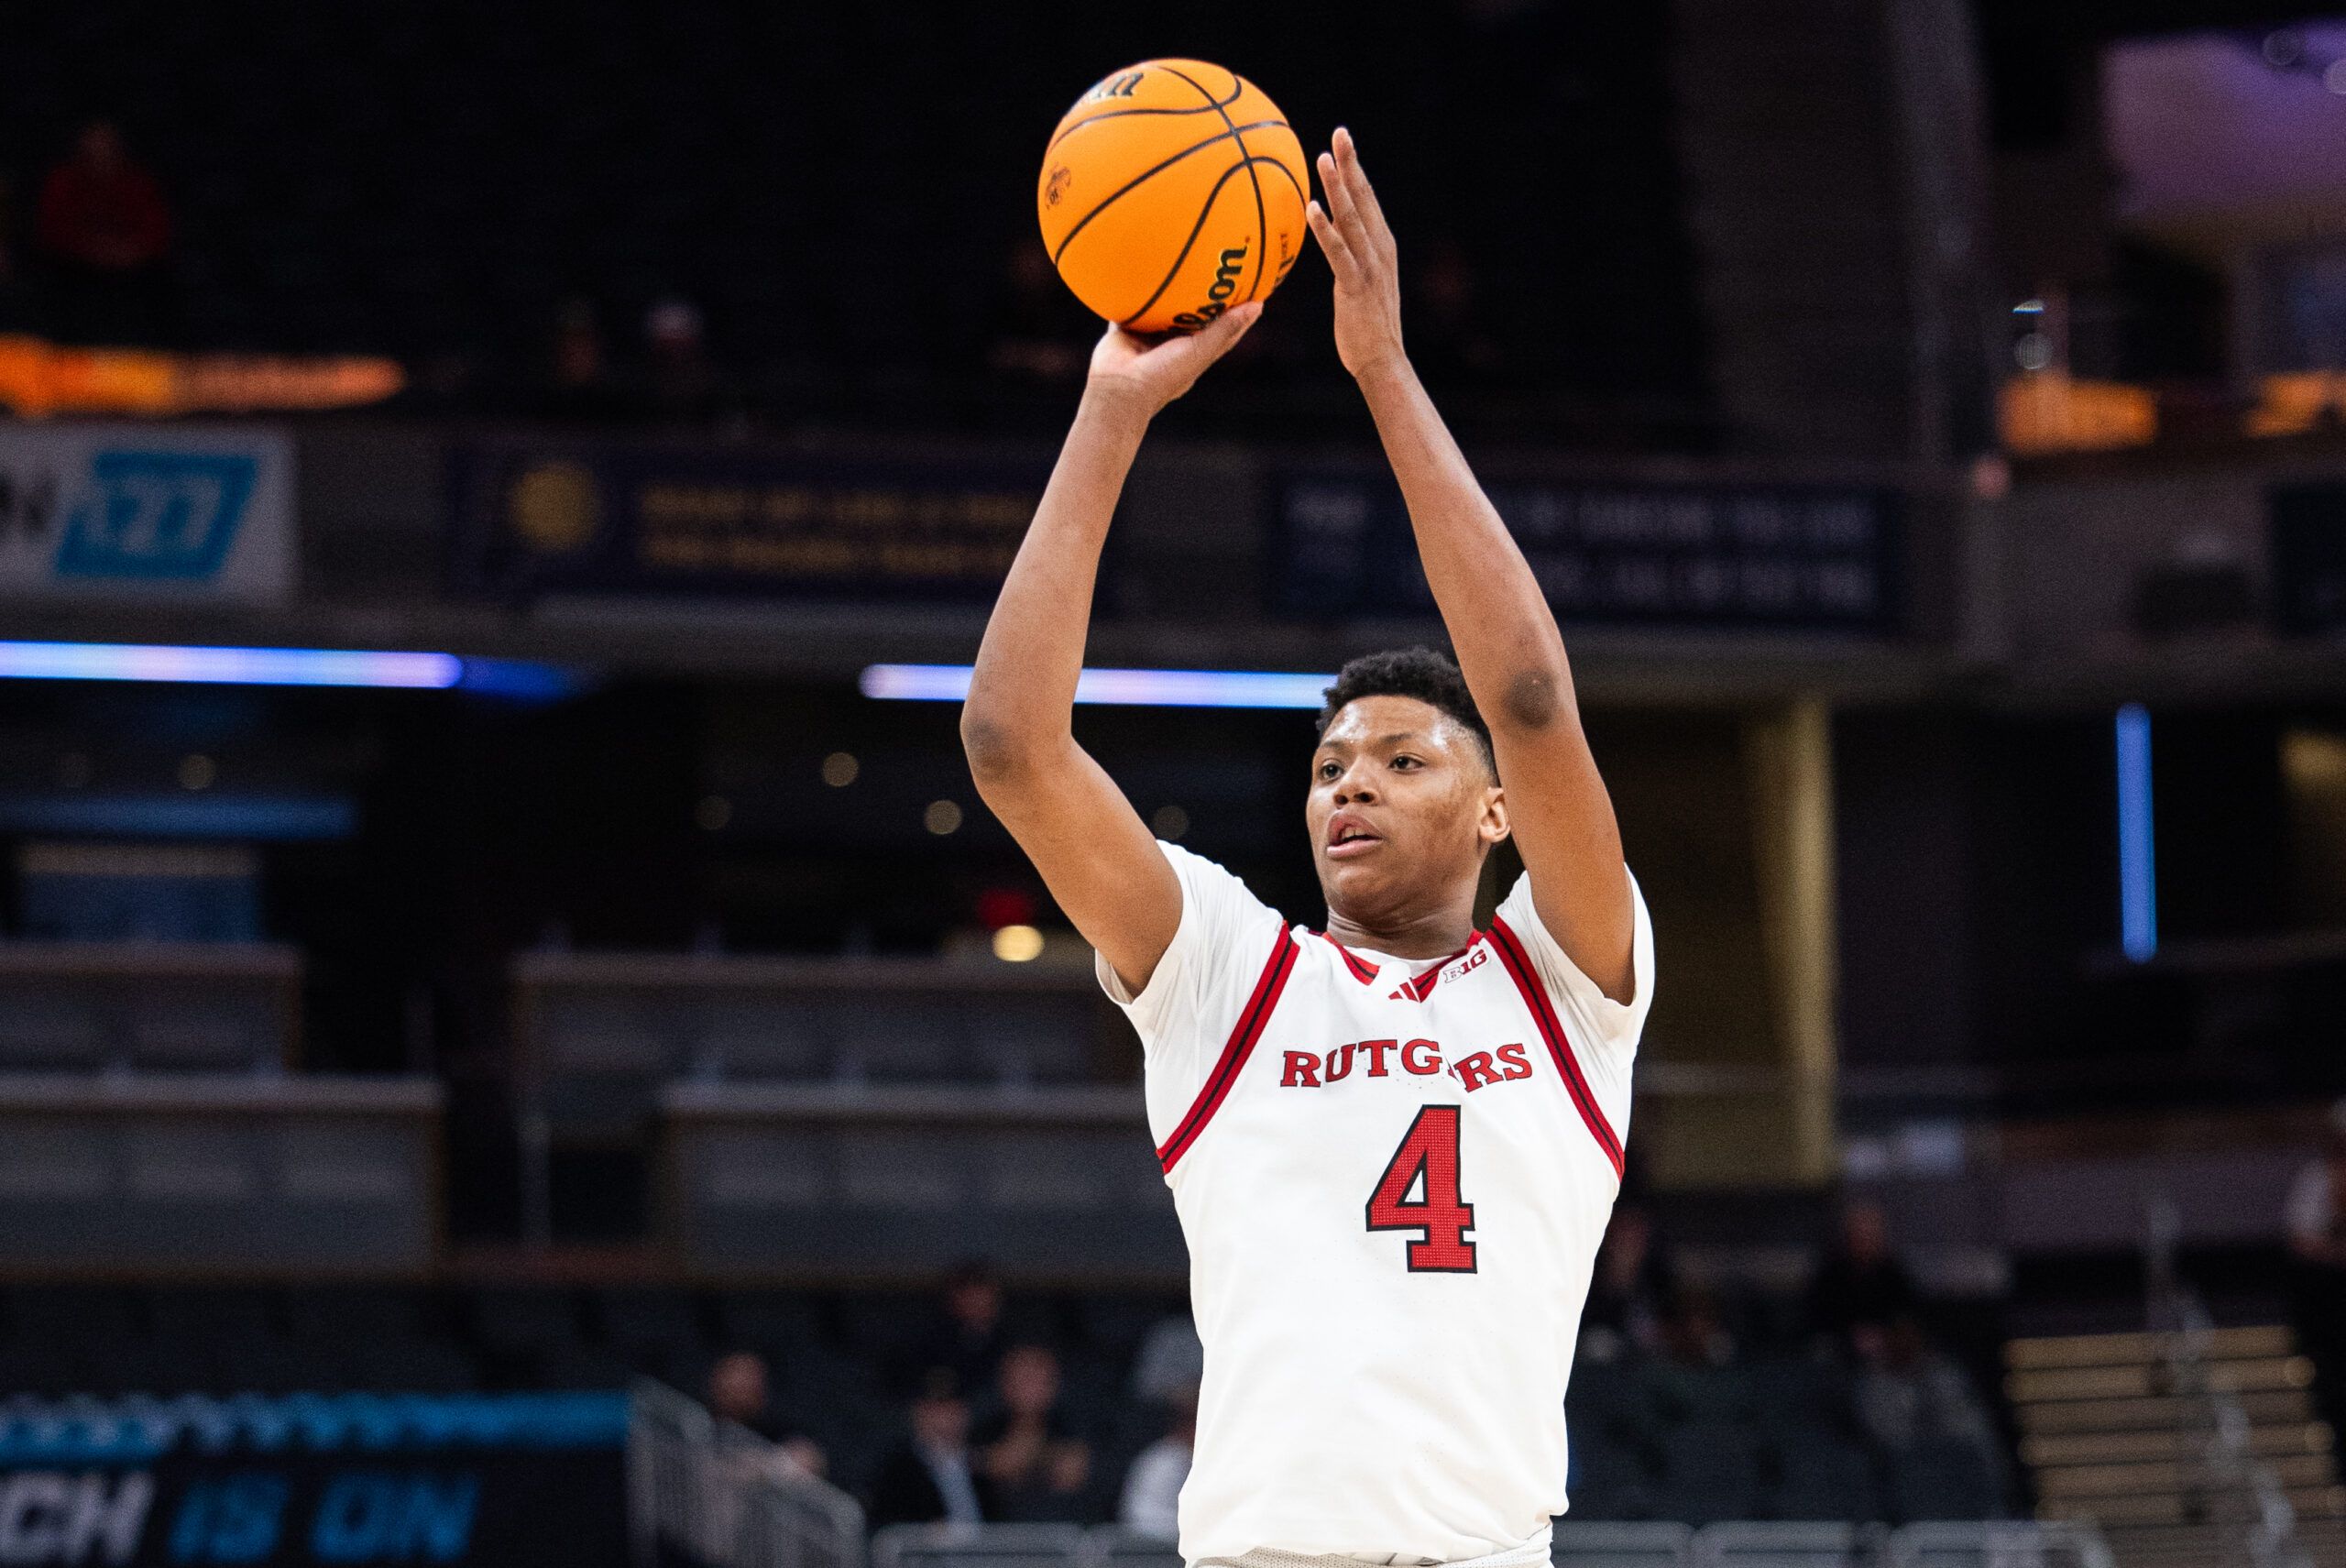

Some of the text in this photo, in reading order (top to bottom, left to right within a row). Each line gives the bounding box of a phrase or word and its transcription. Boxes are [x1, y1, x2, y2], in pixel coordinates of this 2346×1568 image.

[1280, 1038, 1532, 1092] RUTGRS
[1365, 1104, 1477, 1274] 4
[168, 1472, 290, 1563] IS
[310, 1472, 478, 1563] ON
